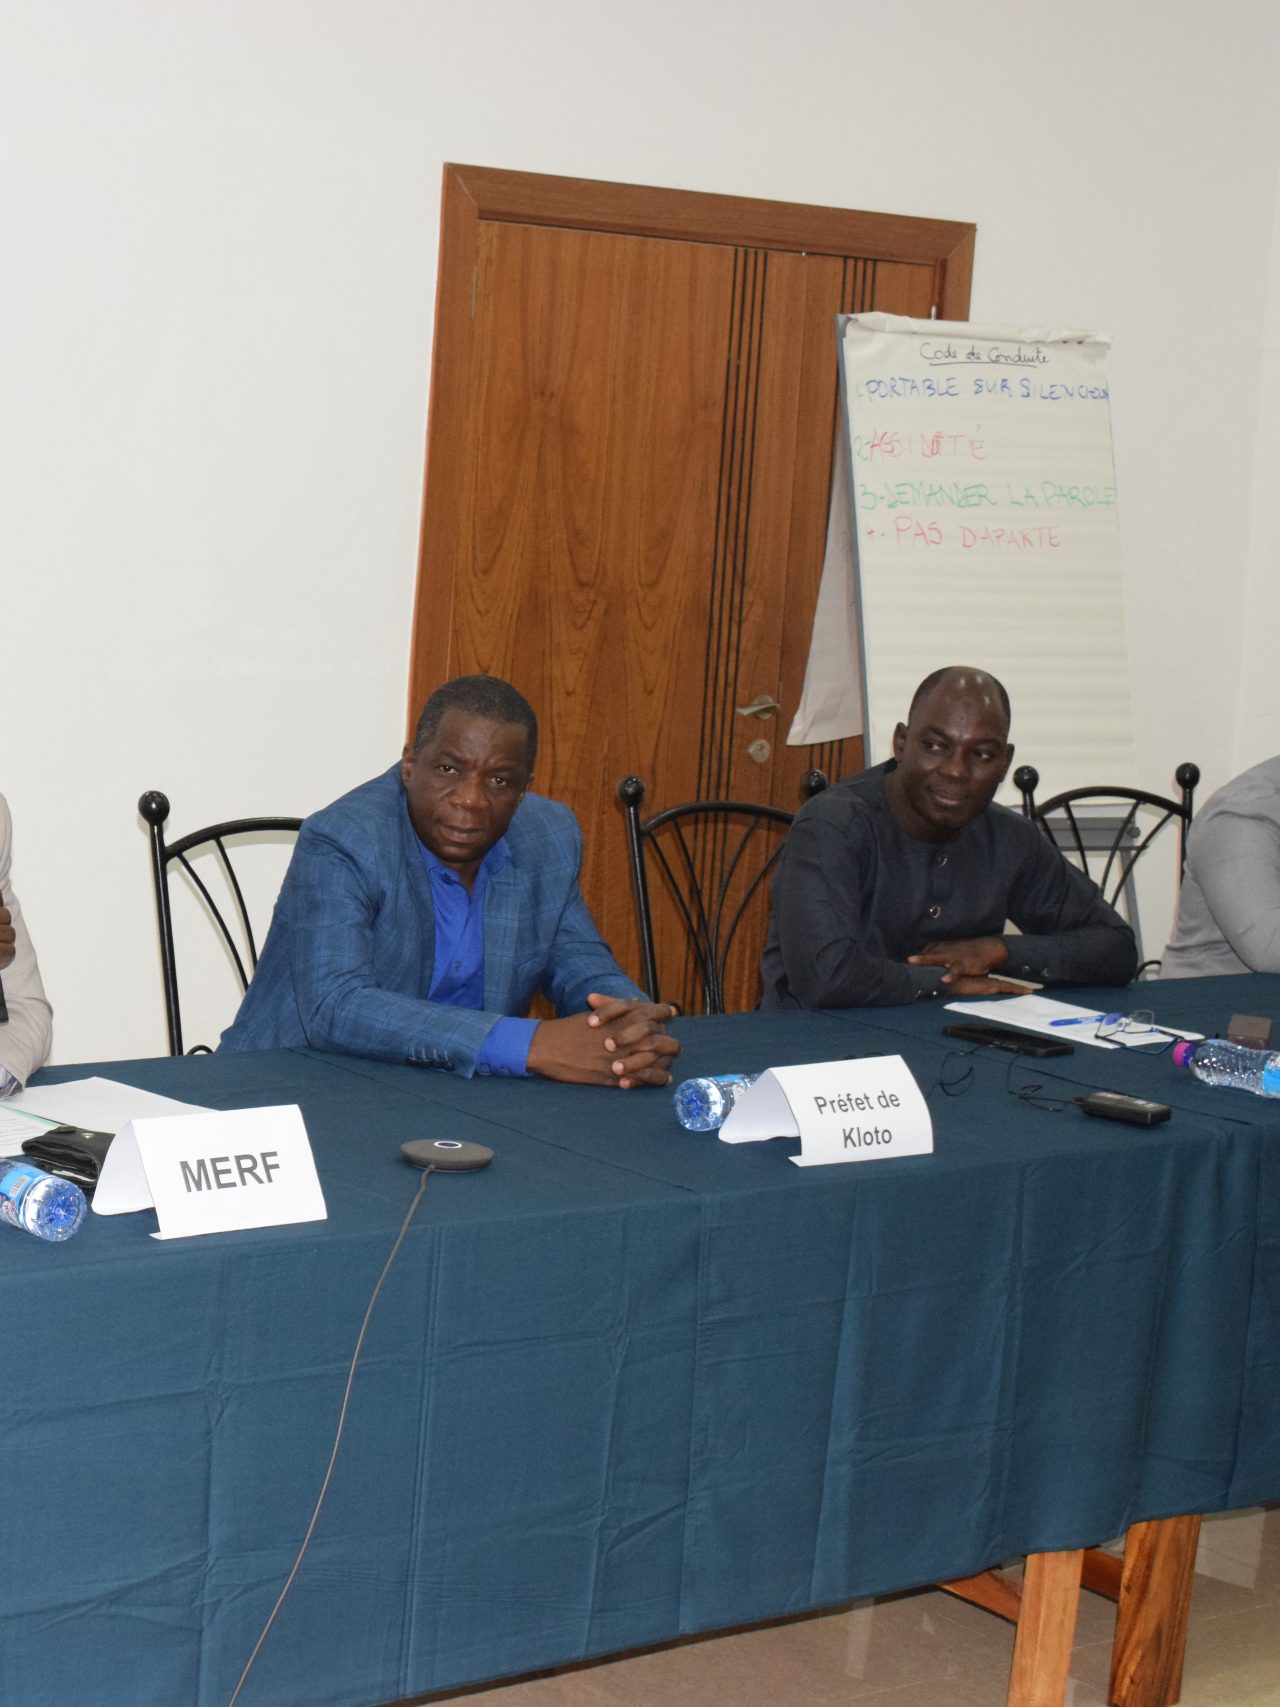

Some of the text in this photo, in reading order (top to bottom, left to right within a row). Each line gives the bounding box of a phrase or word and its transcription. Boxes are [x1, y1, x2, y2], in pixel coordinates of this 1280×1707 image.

[919, 342, 958, 360] Code
[966, 344, 982, 360] de
[973, 378, 1013, 399] SUR
[1006, 482, 1039, 508] LA
[893, 515, 944, 547] PAS
[813, 1089, 901, 1115] Préfet de
[842, 1127, 892, 1149] Kloto
[179, 1151, 282, 1194] MERF
